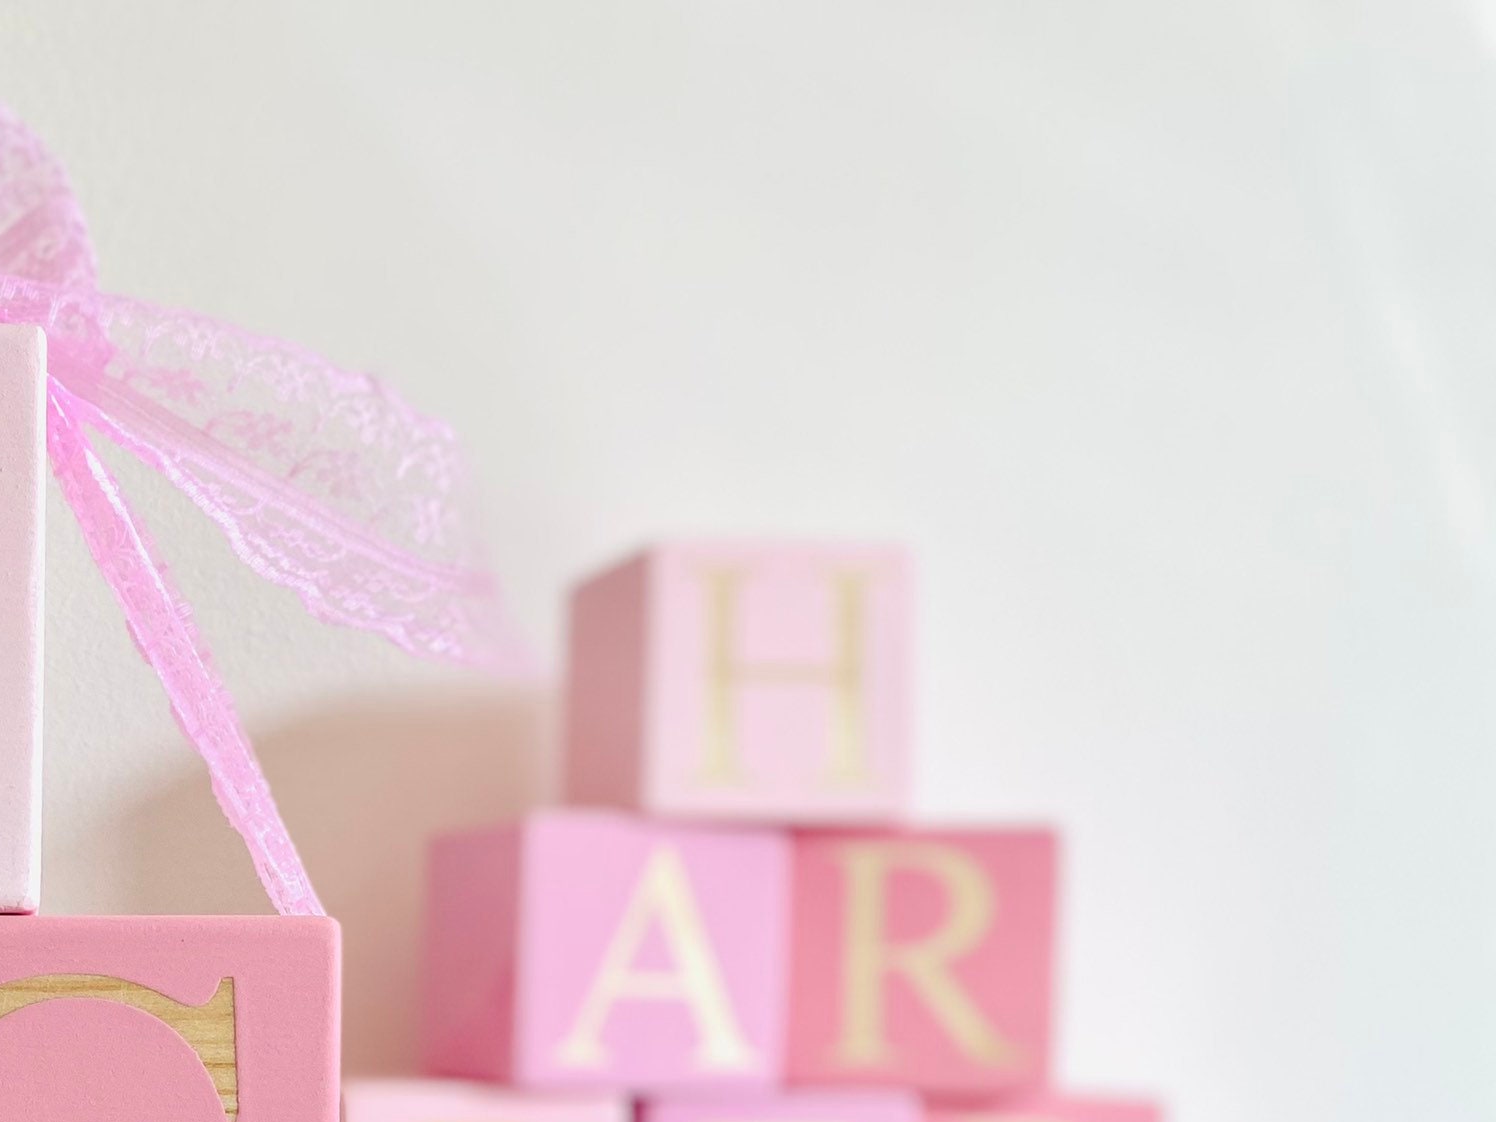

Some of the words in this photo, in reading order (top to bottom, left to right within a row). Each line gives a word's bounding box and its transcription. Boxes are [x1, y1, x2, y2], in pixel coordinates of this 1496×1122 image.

[691, 562, 881, 788] H
[551, 841, 763, 1071] A
[828, 839, 1030, 1071] R
